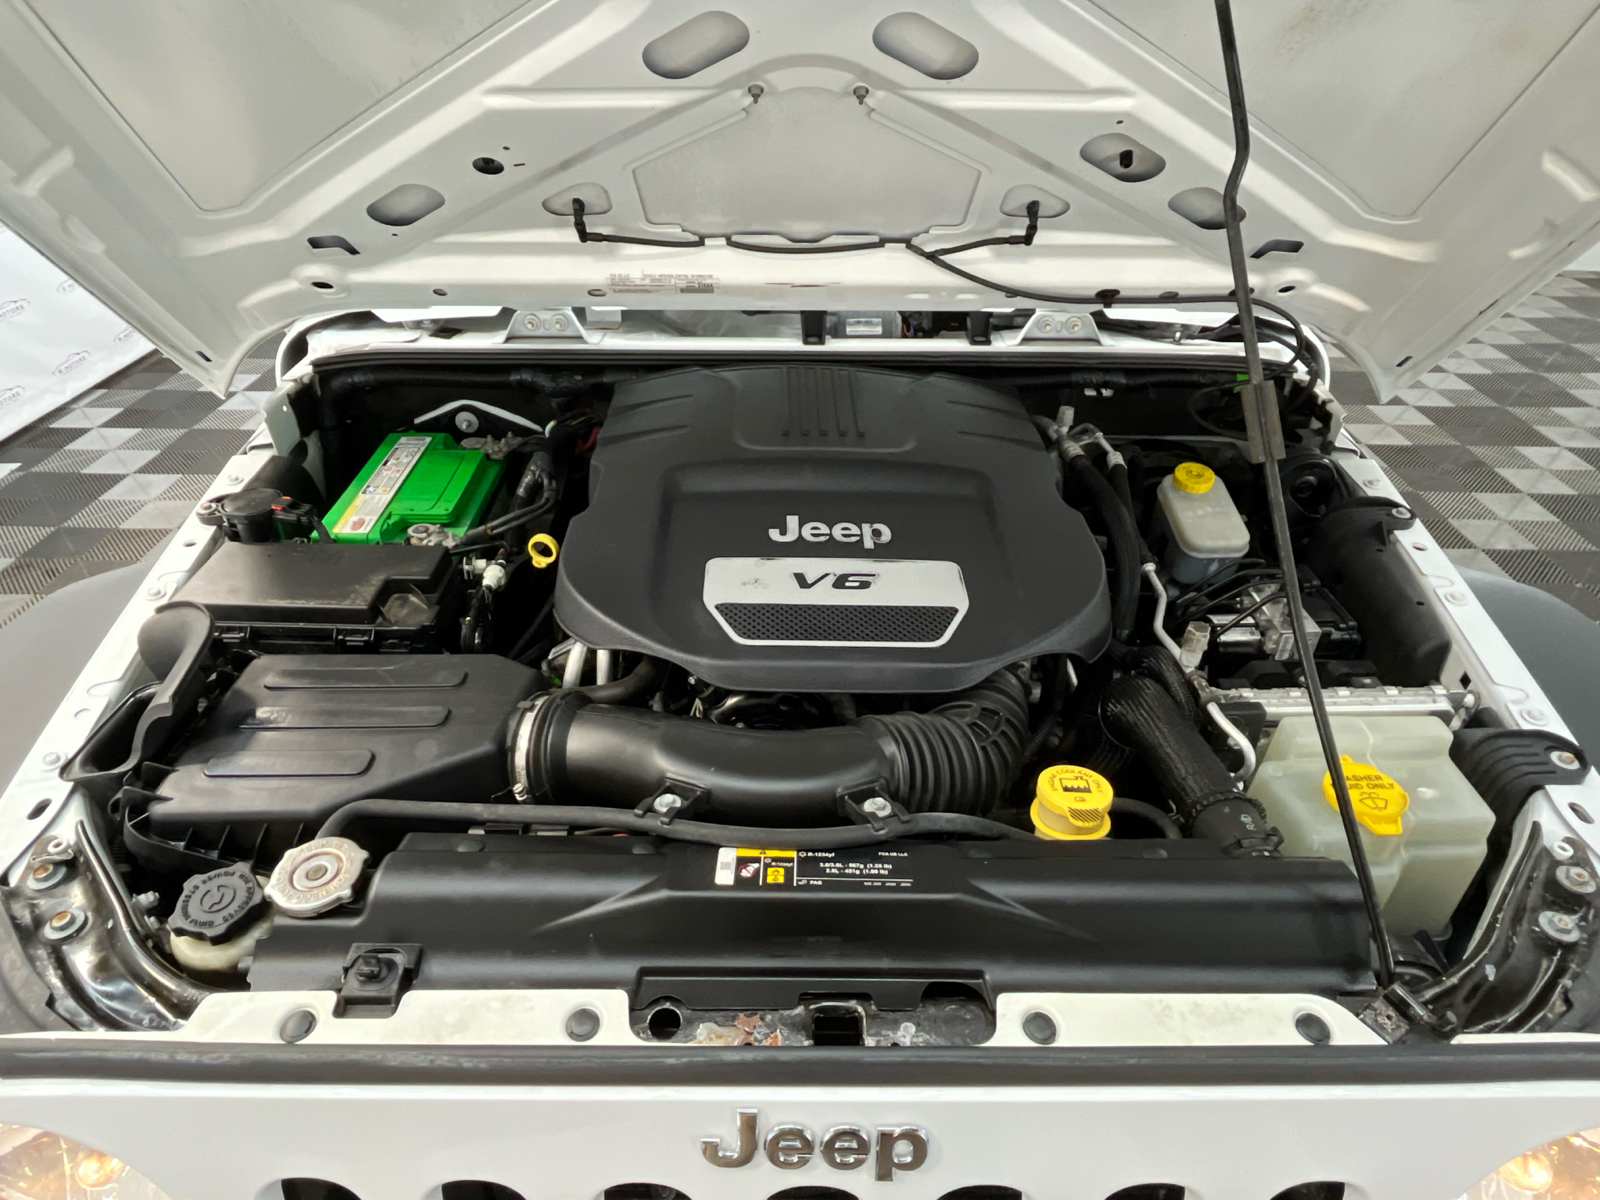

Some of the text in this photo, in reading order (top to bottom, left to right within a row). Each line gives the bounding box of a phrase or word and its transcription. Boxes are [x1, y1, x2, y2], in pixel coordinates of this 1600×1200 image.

[768, 514, 892, 549] Jeep
[792, 572, 878, 590] V6
[1344, 774, 1384, 782] ASHER
[700, 1108, 930, 1182] Jeep
